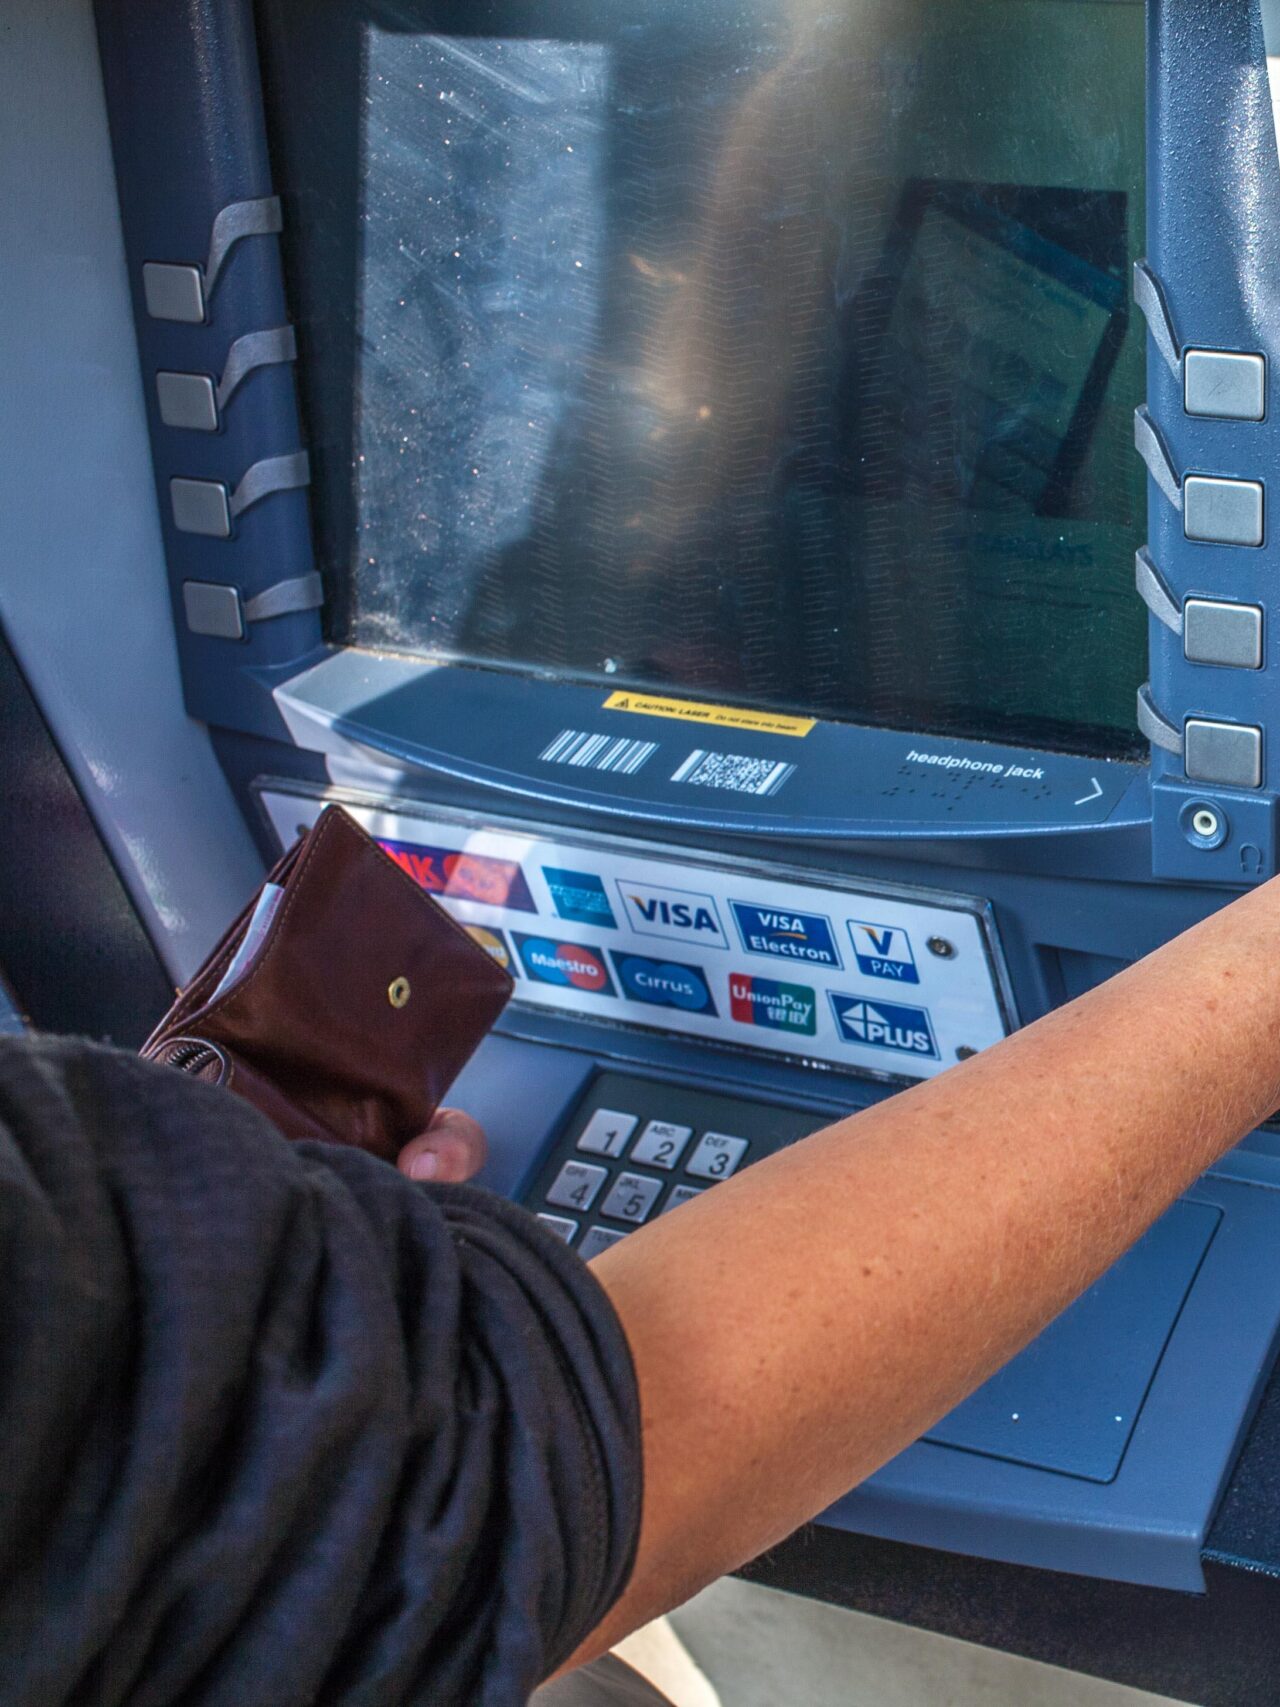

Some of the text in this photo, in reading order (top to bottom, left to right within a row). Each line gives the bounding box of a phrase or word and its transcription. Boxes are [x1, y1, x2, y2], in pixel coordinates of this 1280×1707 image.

[678, 708, 711, 718] LASER
[906, 750, 1045, 779] headphone jack
[628, 894, 719, 934] VISA
[757, 912, 805, 933] VISA
[750, 936, 831, 962] Electron
[858, 926, 893, 956] V
[531, 953, 598, 976] Maestro
[870, 959, 905, 977] PAY
[635, 972, 694, 995] Cirrus
[732, 984, 812, 1018] UnionPay
[868, 1024, 930, 1051] PLUS
[605, 1129, 618, 1152] 1
[651, 1125, 676, 1138] ABC
[704, 1136, 729, 1148] DEF
[653, 1141, 675, 1163] 2
[709, 1153, 730, 1175] 3
[570, 1183, 589, 1205] 4
[623, 1195, 645, 1216] 5
